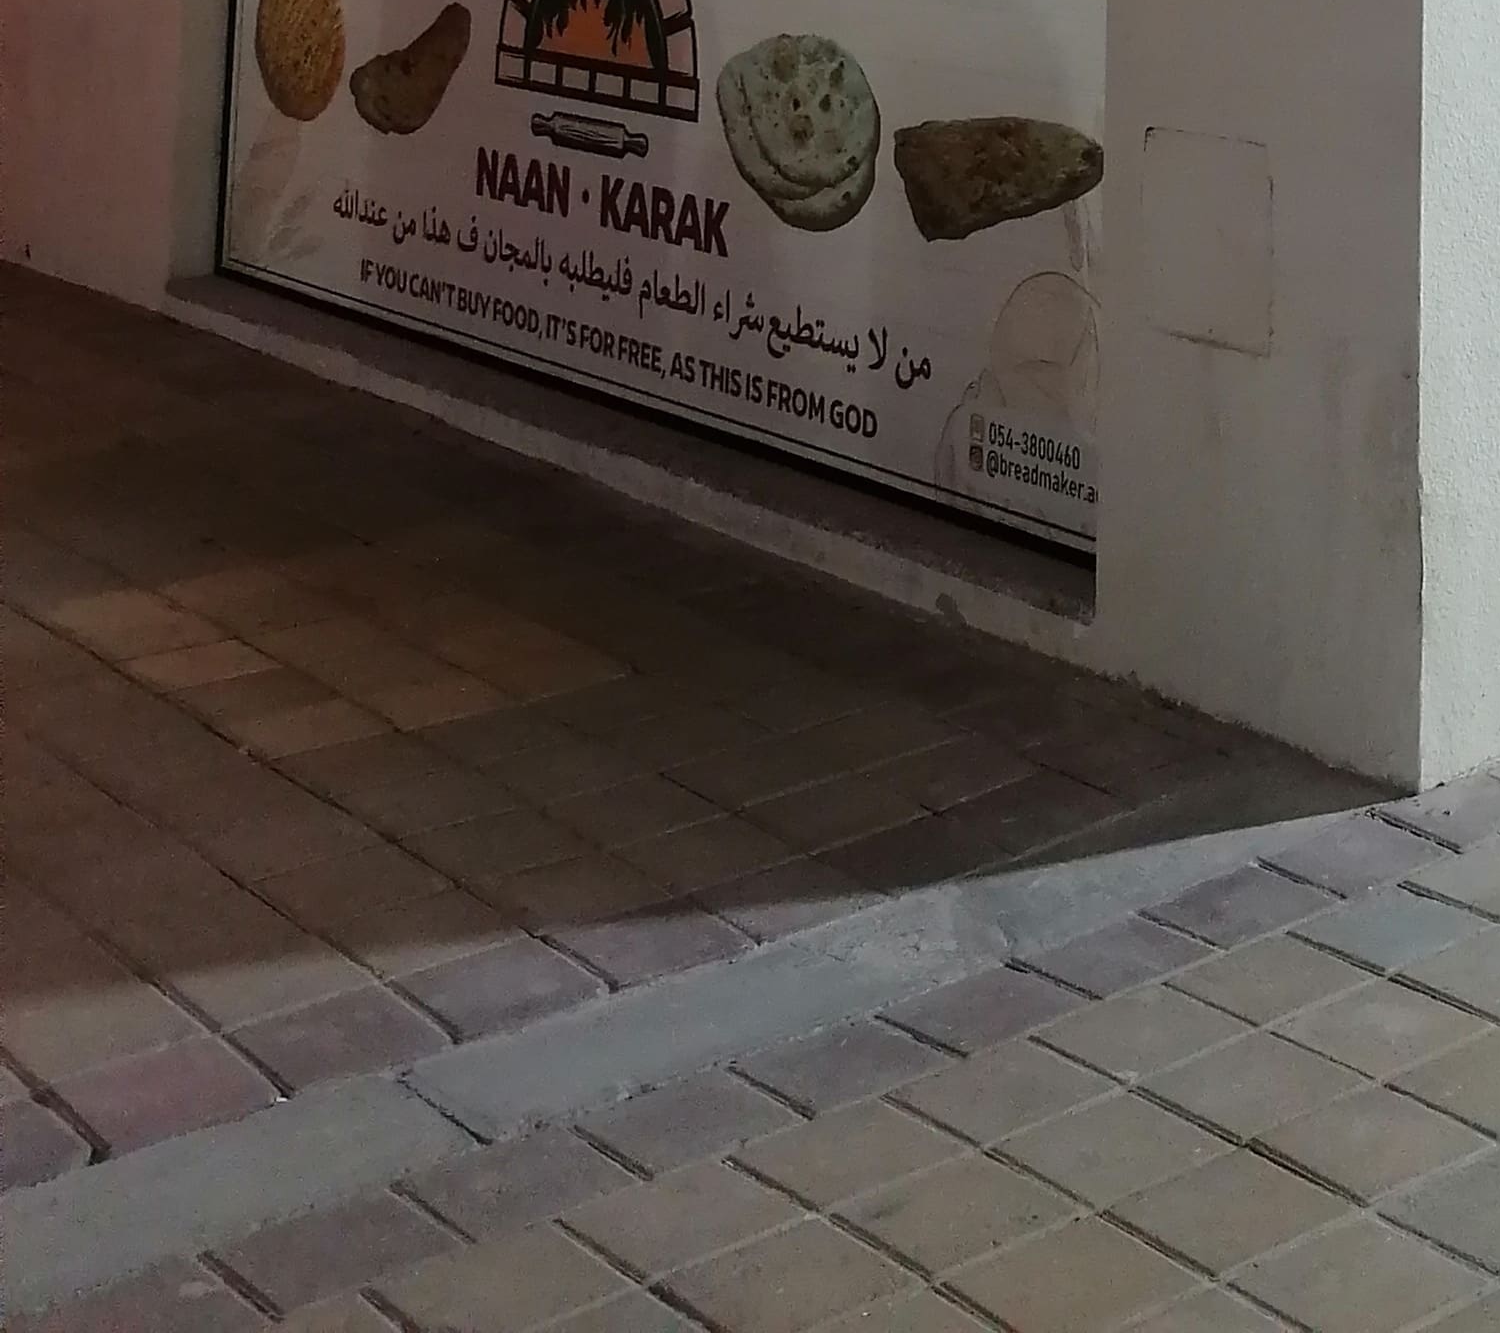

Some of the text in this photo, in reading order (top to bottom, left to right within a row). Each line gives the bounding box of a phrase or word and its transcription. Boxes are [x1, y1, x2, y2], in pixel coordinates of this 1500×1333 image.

[423, 206, 451, 245] هذا
[476, 146, 730, 257] NAAN KARAK
[392, 211, 416, 244] من
[457, 215, 478, 252] ف
[483, 229, 552, 286] بالمجان
[559, 250, 633, 301] فليطلبه
[640, 270, 705, 319] الطعام
[360, 258, 879, 439] IF YOU CAN'T BUY FOOD, IT'S FOR FREE, AS THIS IS FROM GOD
[767, 304, 859, 373] يستطيع
[868, 326, 887, 370] لا
[895, 347, 931, 389] من
[988, 421, 1081, 470] 054-3800460
